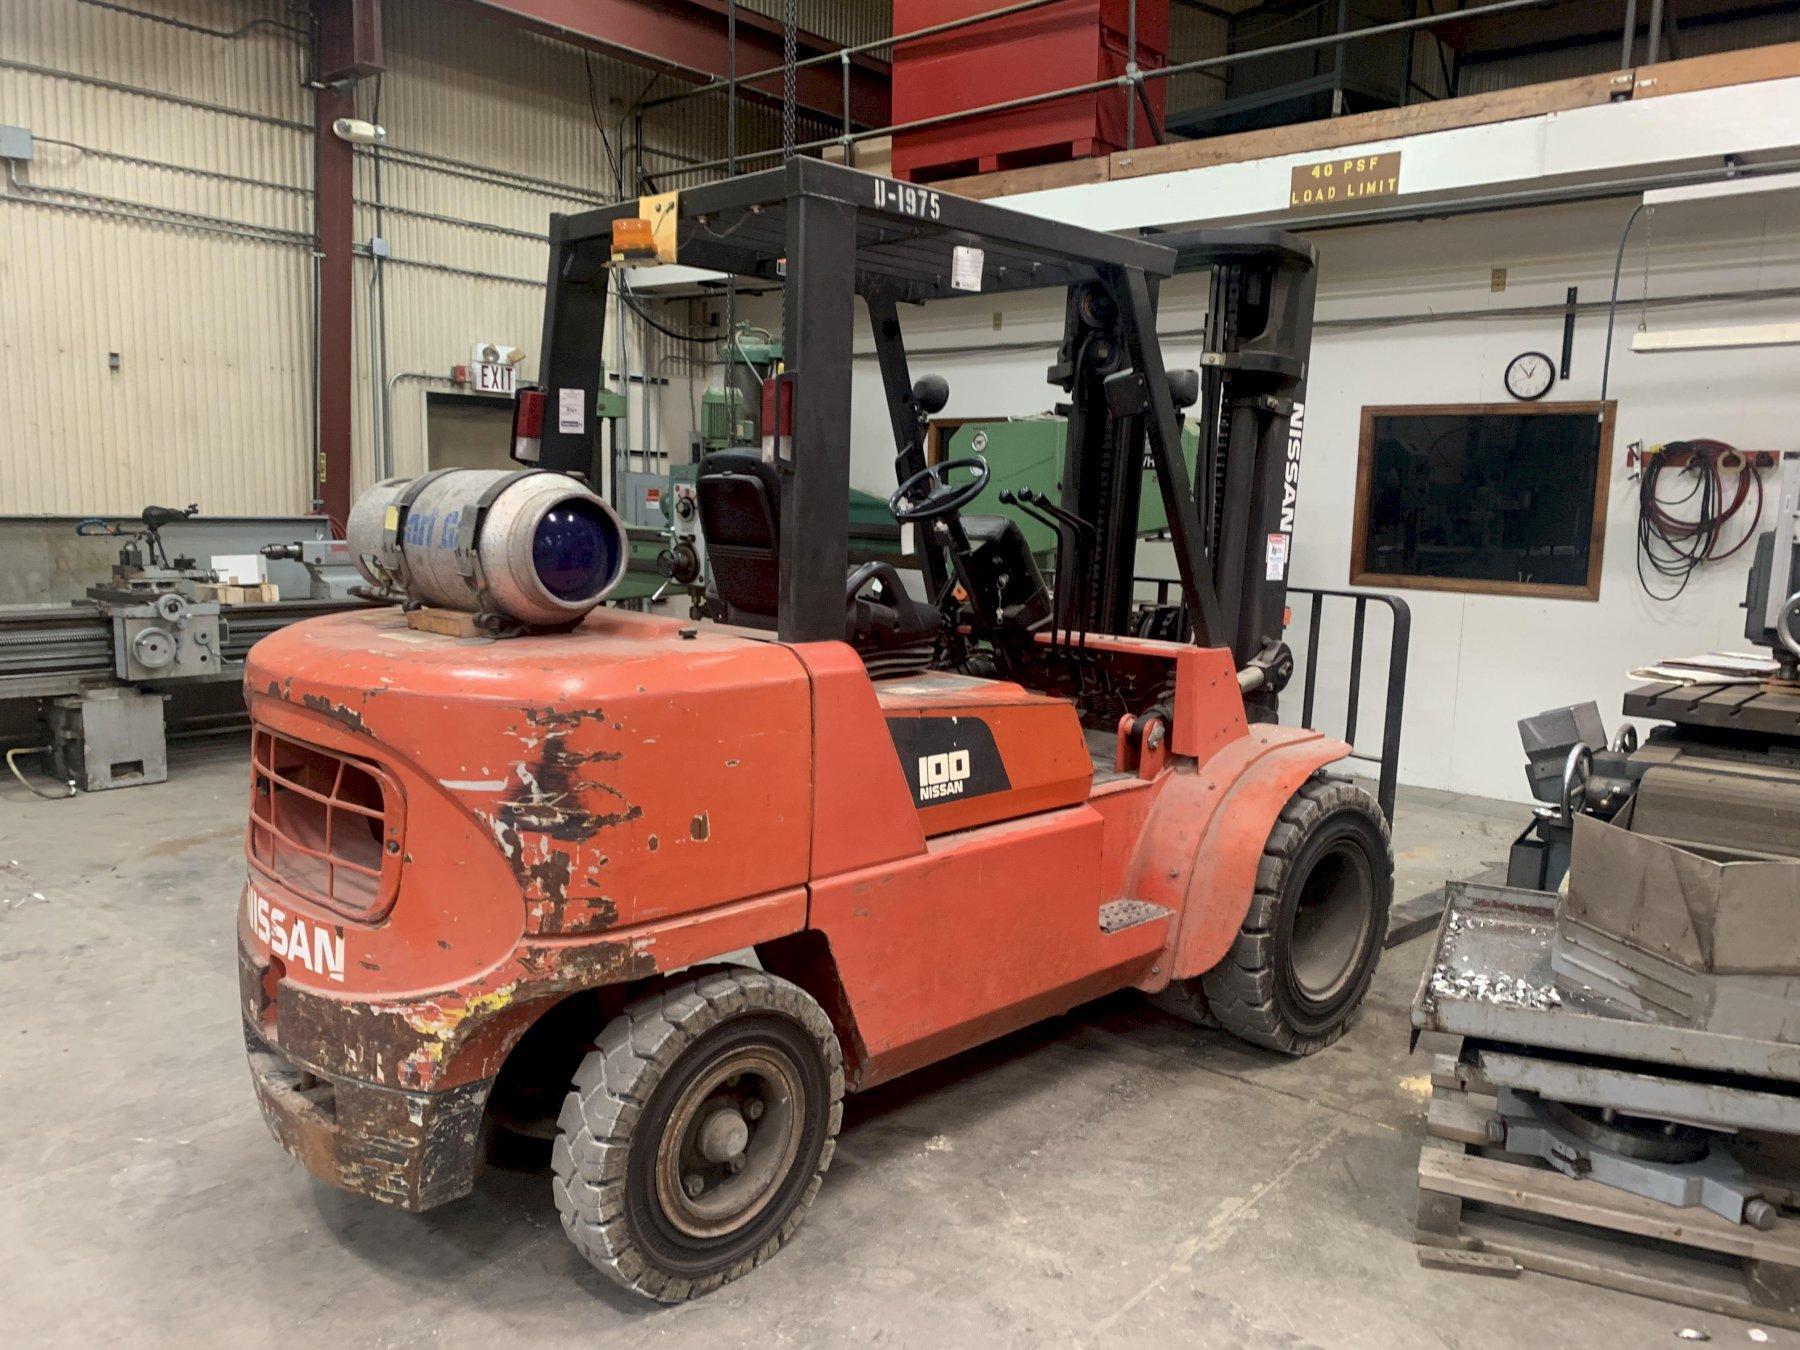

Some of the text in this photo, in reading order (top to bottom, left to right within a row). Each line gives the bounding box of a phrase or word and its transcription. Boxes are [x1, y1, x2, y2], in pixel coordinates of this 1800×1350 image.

[1311, 156, 1379, 179] 40 PSF
[1291, 178, 1397, 205] LOAD LIMIT
[481, 364, 513, 391] EXIT
[1279, 401, 1305, 532] NISSAN
[918, 749, 971, 787] 100
[920, 780, 964, 801] NISSAN
